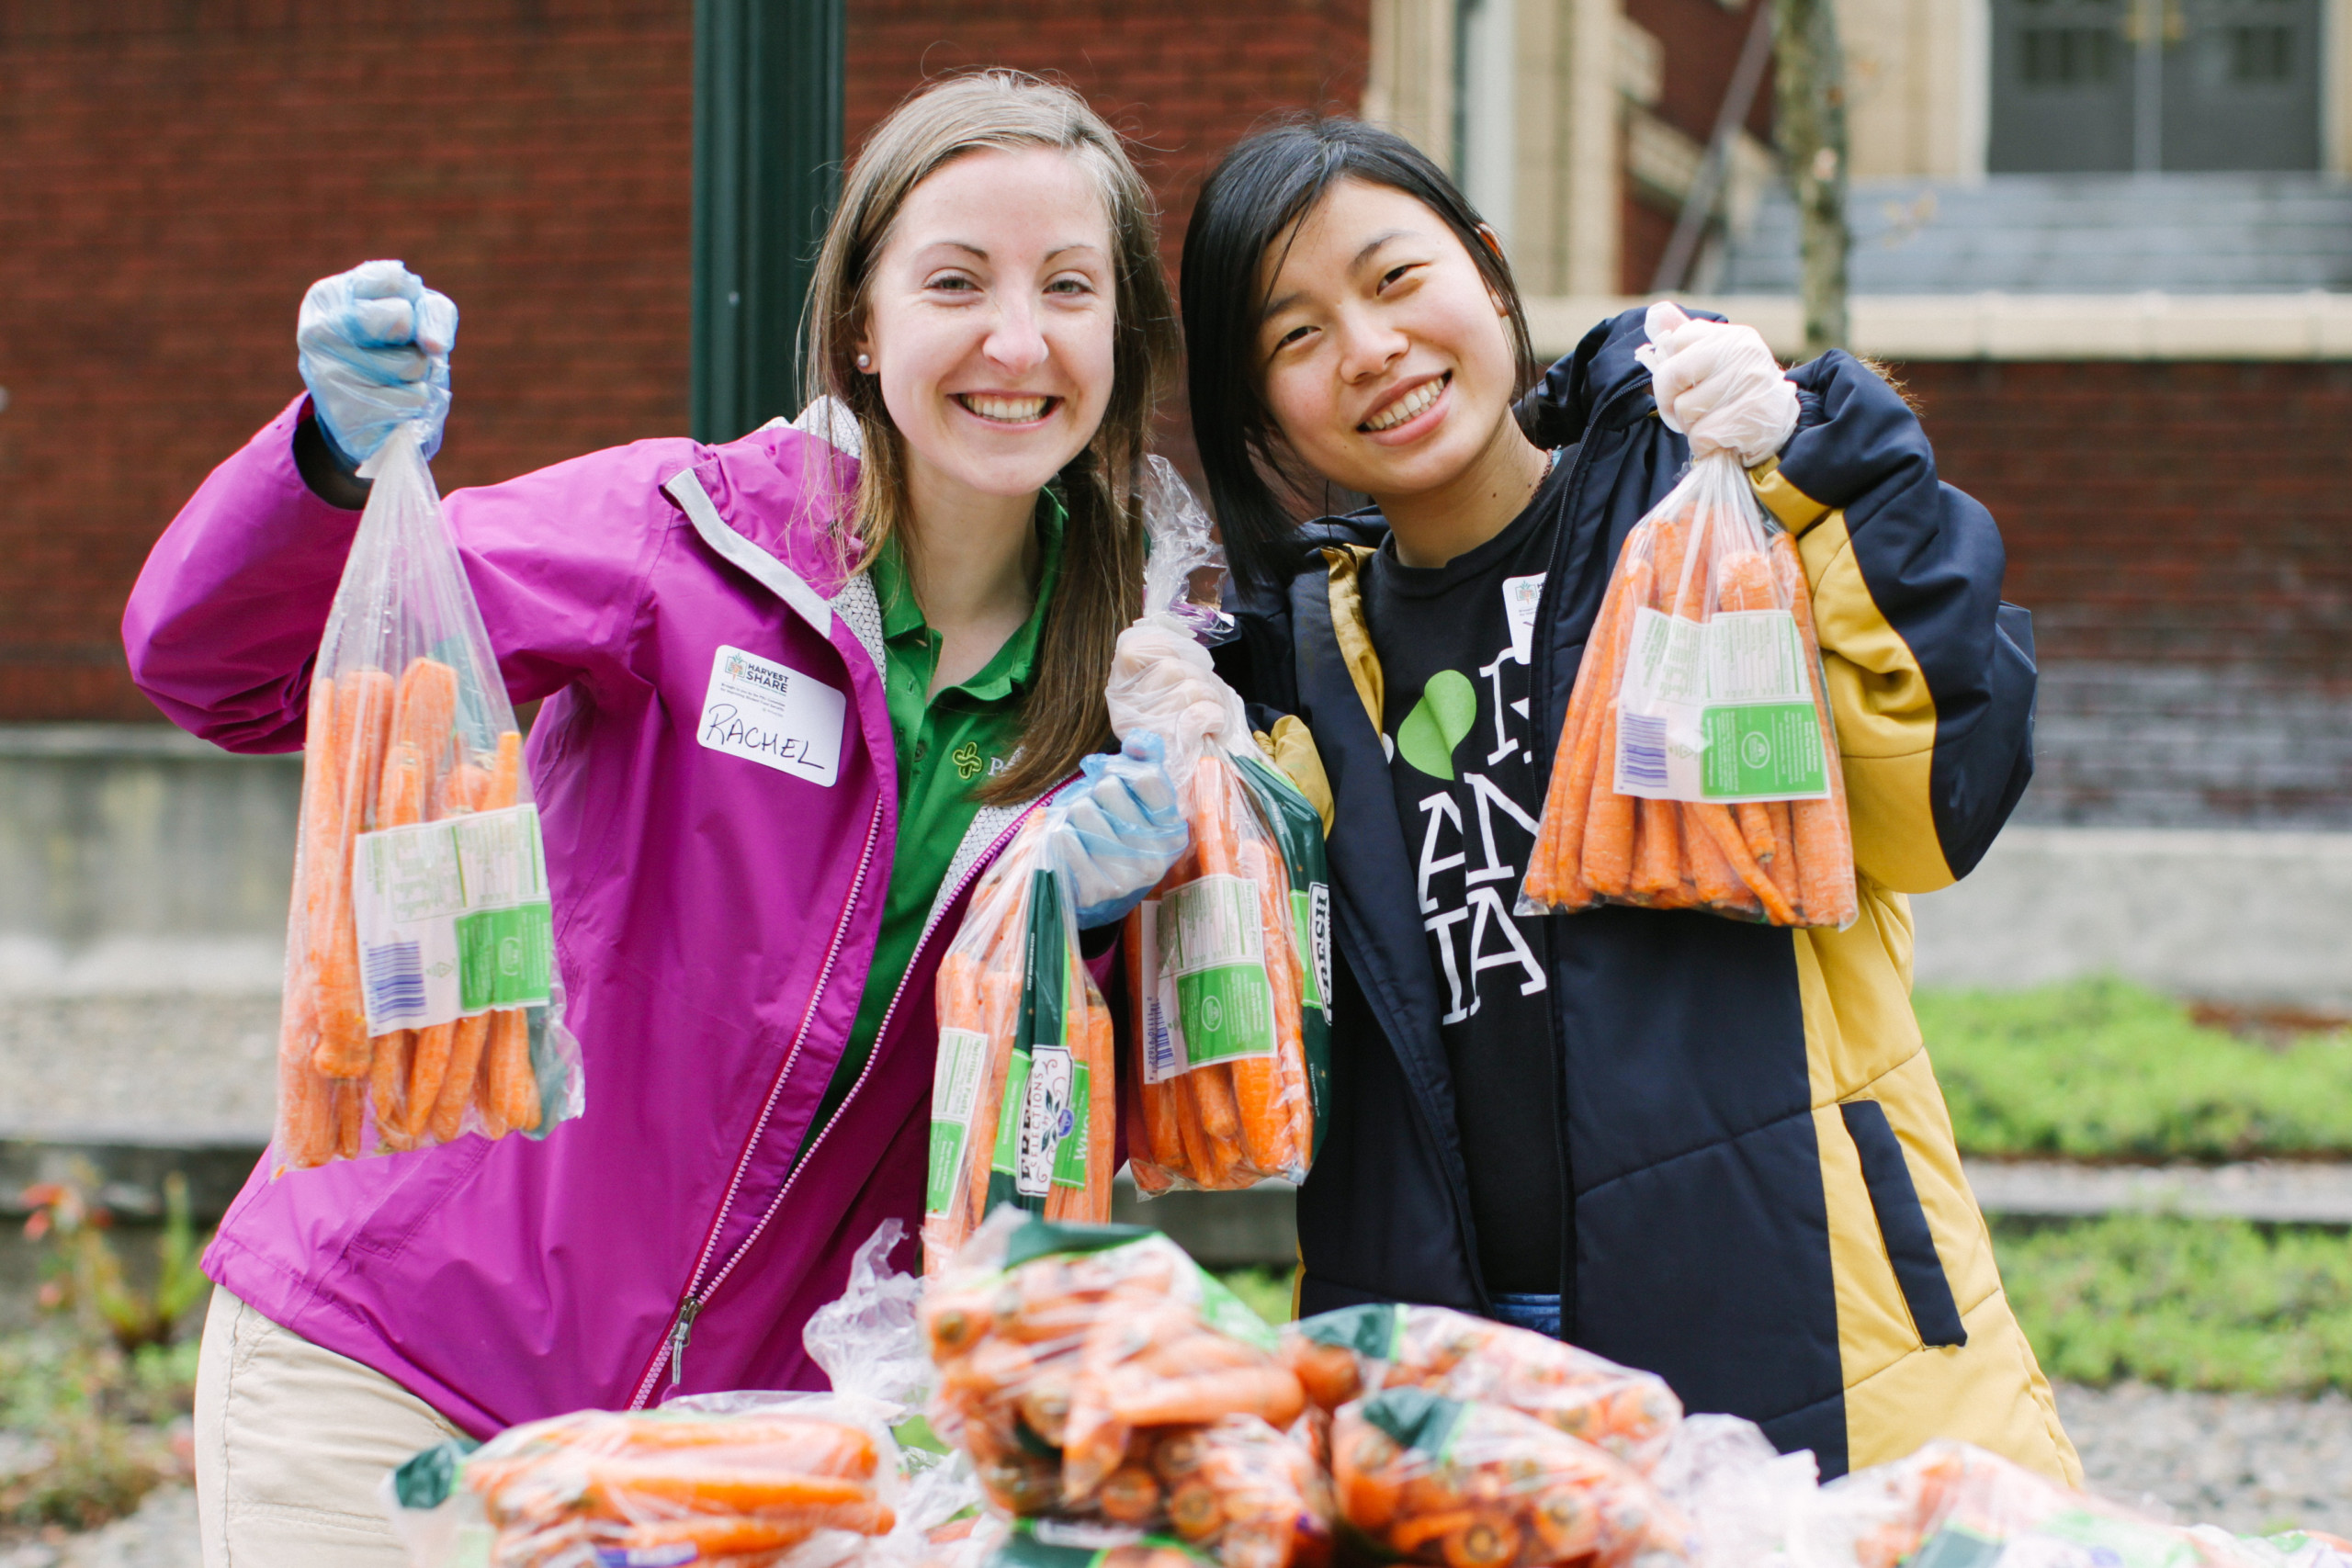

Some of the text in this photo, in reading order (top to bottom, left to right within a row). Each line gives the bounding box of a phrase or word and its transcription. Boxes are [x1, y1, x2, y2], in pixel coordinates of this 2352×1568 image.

[746, 671, 788, 693] SHARE
[748, 663, 789, 682] HARVEST
[707, 704, 825, 770] RACHEL
[1022, 1087, 1032, 1180] FRE
[1030, 1073, 1044, 1168] SELECTIONS
